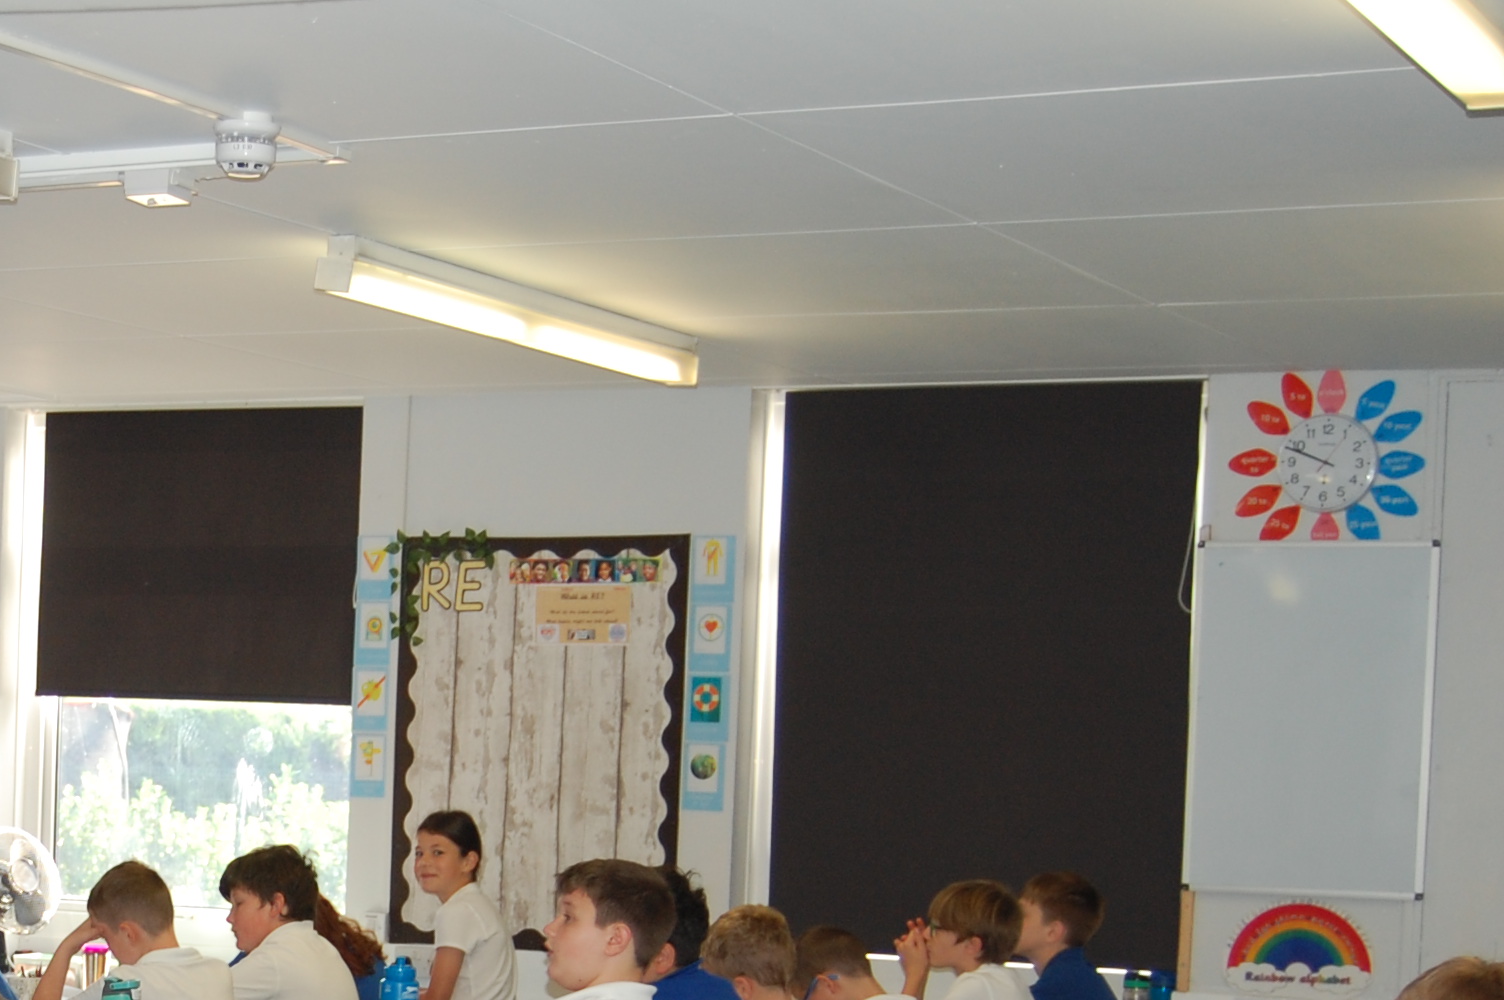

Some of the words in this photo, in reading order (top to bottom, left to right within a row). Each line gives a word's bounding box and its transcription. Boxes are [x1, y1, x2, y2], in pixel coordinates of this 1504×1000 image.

[1307, 428, 1316, 438] 11
[1323, 424, 1335, 435] 12
[1343, 429, 1347, 439] 1
[1292, 440, 1306, 453] 10
[1353, 441, 1362, 452] 2
[1287, 457, 1296, 467] 9
[1355, 457, 1364, 468] 3
[1290, 474, 1299, 484] 8
[1349, 474, 1358, 485] 4
[1302, 486, 1311, 497] 7
[1318, 491, 1327, 502] 6
[1336, 486, 1345, 497] 5
[419, 559, 486, 613] RE
[1245, 971, 1295, 983] Rainbow
[1300, 972, 1351, 986] alphabet
